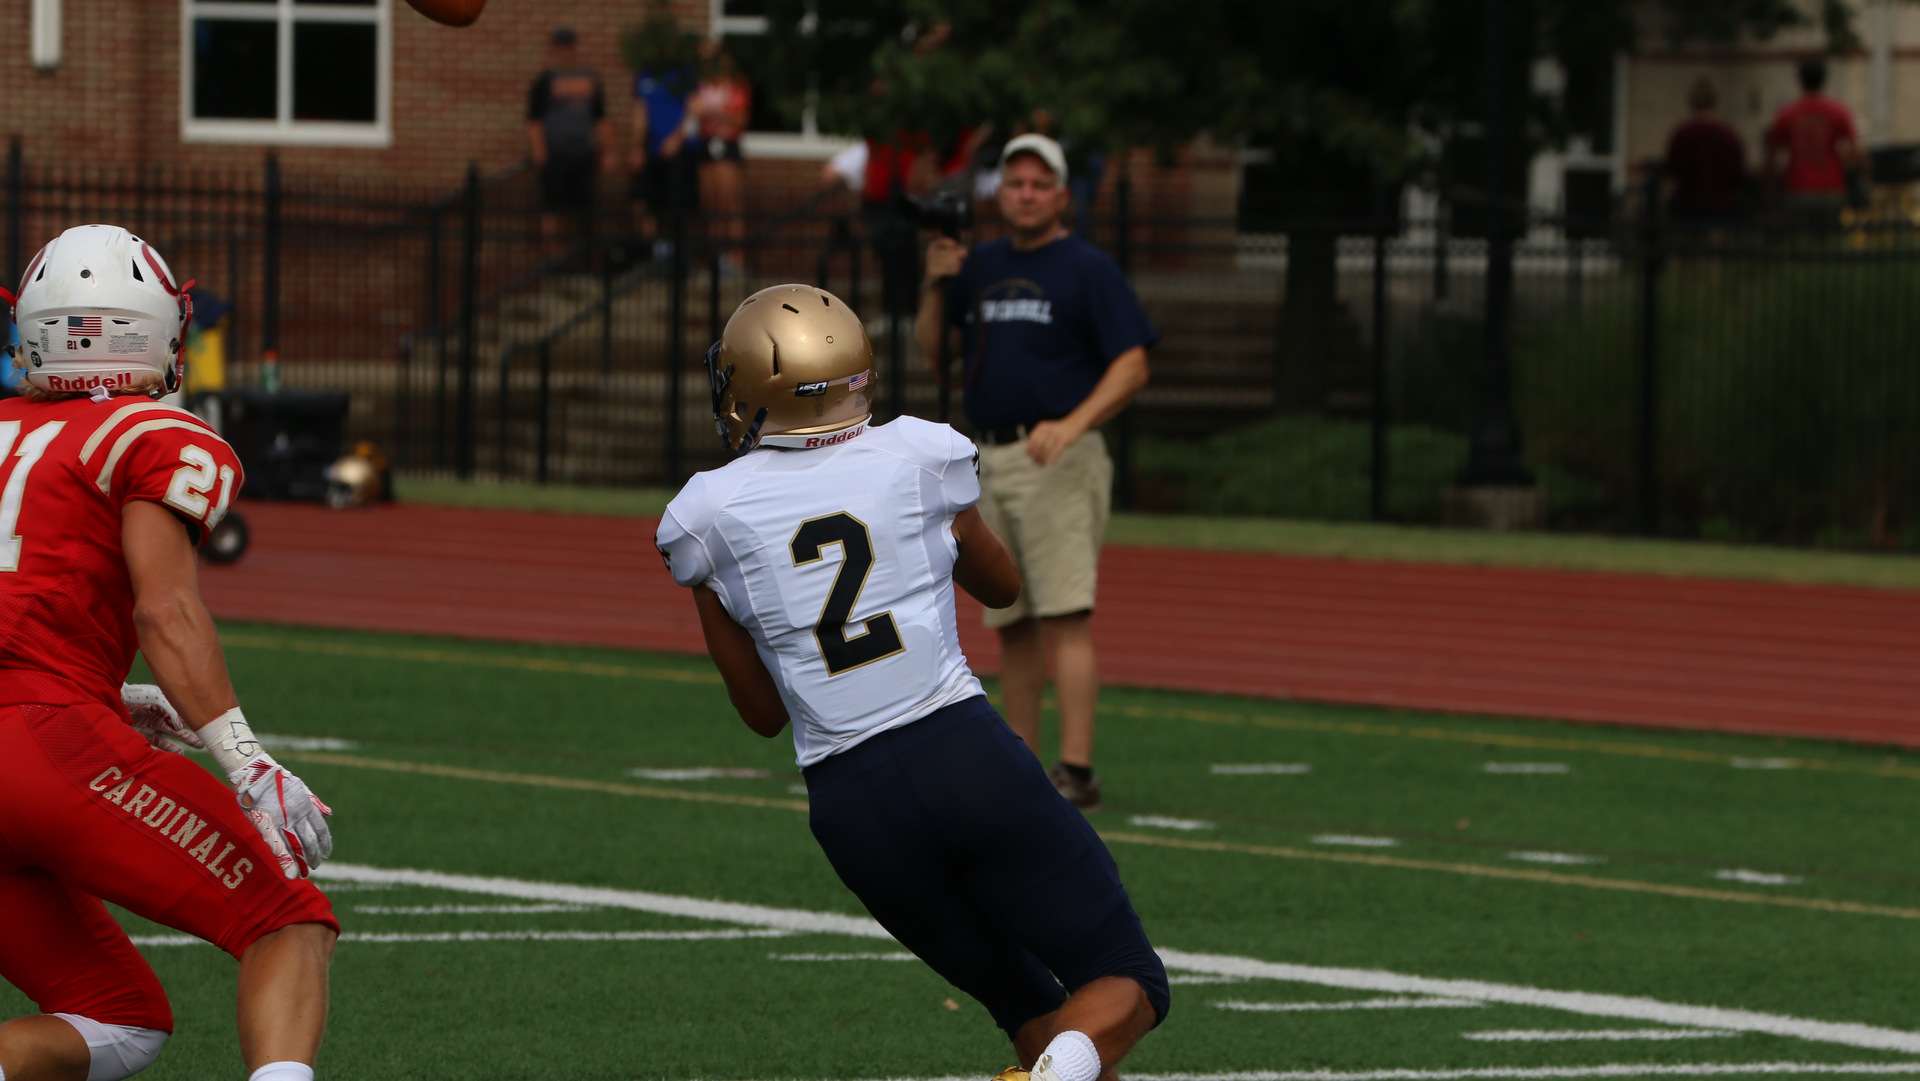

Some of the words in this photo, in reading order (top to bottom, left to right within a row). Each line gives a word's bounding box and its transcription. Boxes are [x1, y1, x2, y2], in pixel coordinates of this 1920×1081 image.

[47, 372, 132, 391] Riddell
[66, 340, 78, 350] 21
[805, 424, 865, 448] Riddell
[0, 420, 69, 572] 1
[162, 443, 235, 533] 21
[788, 510, 907, 678] 2
[88, 766, 253, 890] CARDINALS
